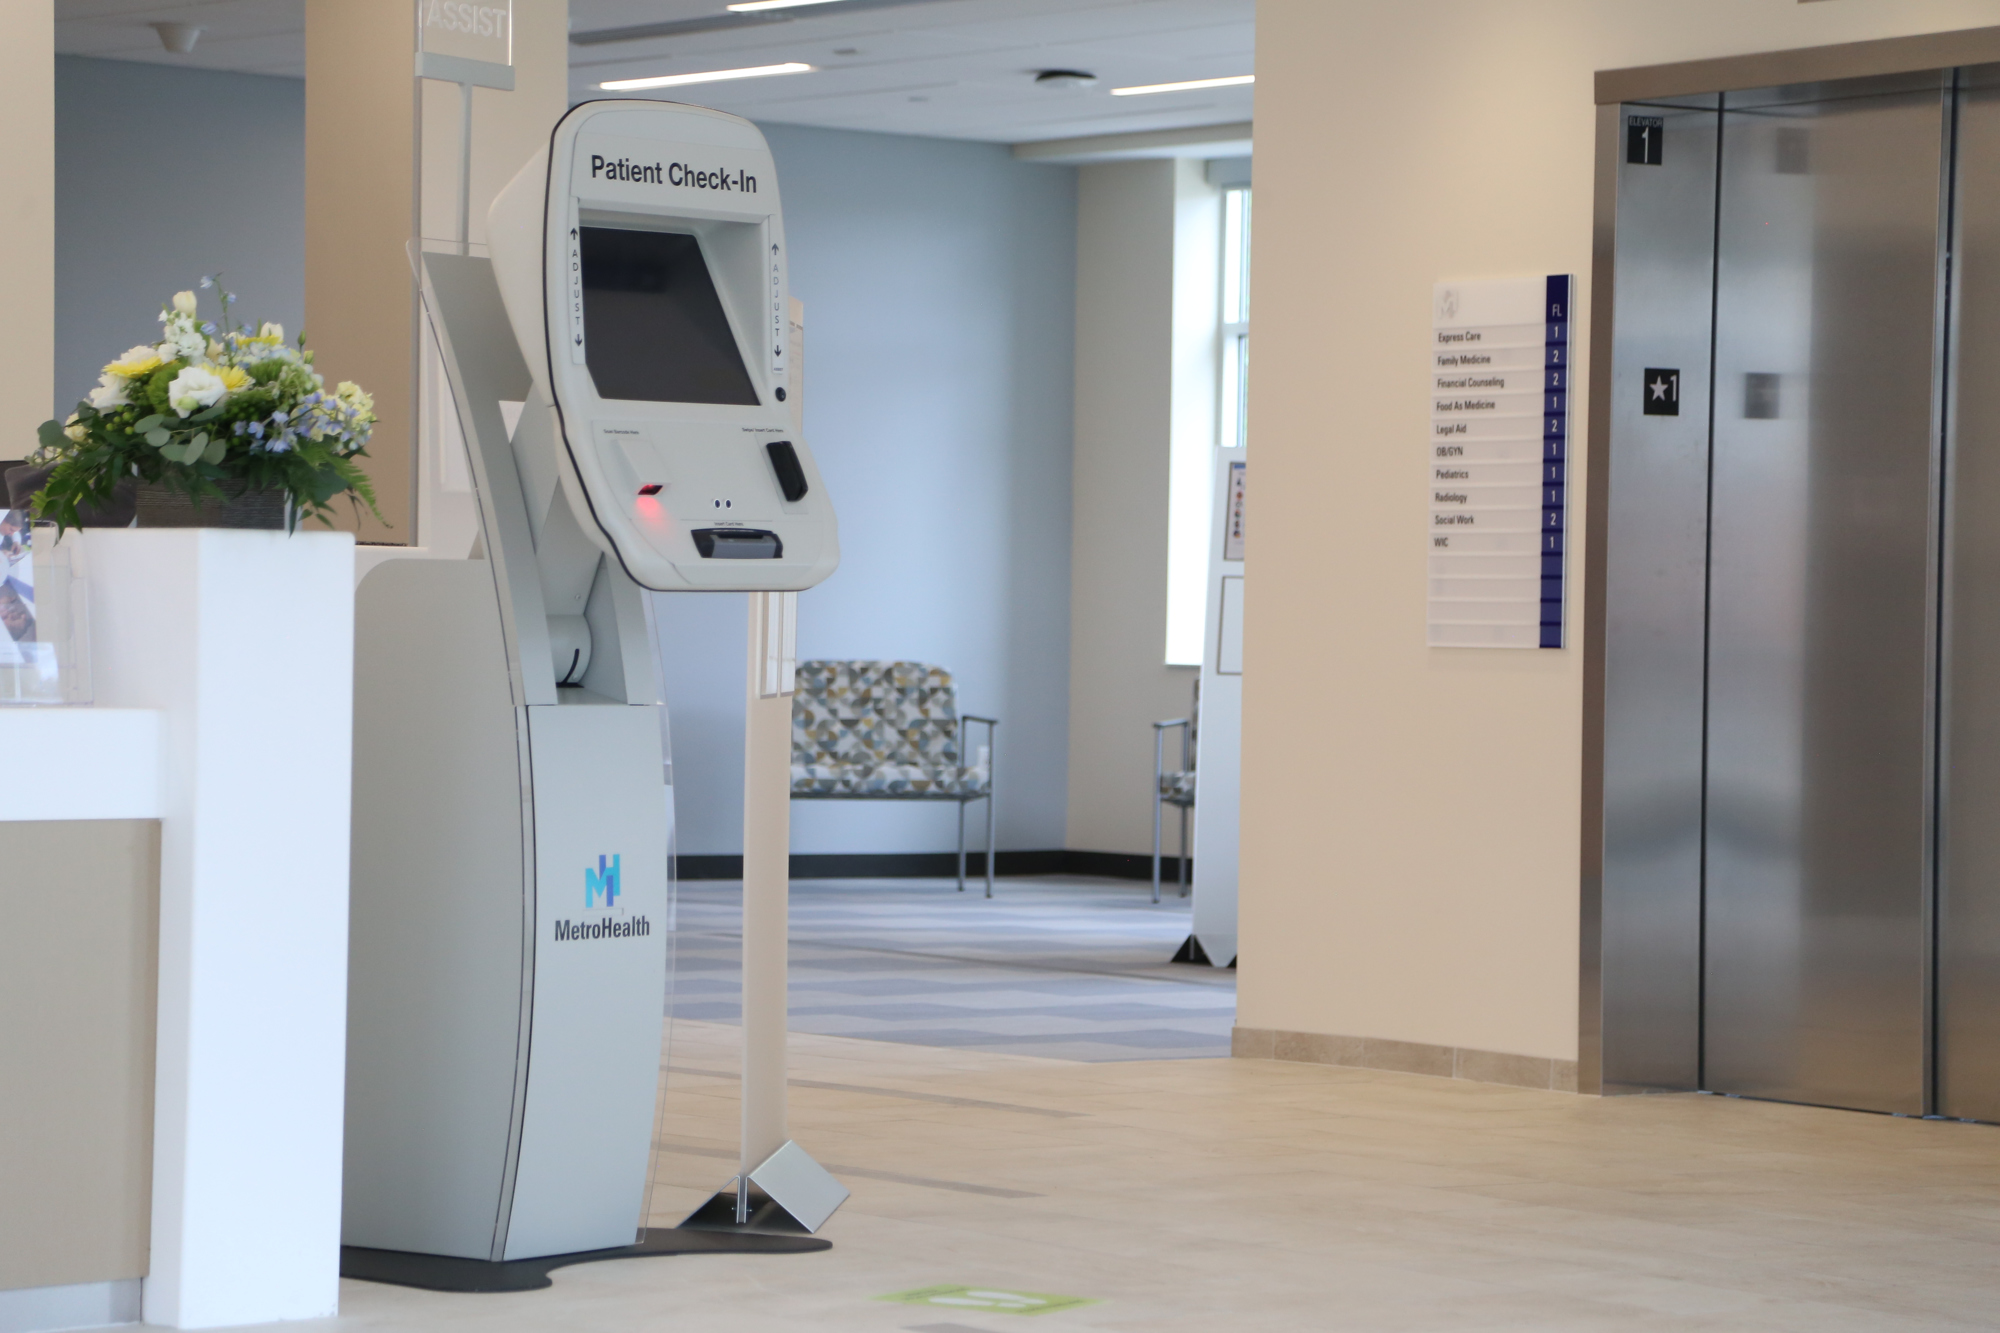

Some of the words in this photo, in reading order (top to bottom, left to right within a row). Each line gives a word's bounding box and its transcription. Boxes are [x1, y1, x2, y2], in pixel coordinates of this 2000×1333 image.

[426, 0, 507, 39] ASSIST
[1629, 117, 1663, 128] ELEVATOR
[1641, 126, 1649, 164] 1
[591, 154, 663, 185] Patient
[668, 162, 757, 194] Check-In
[572, 249, 581, 325] ADJUST
[772, 264, 780, 337] ADJUST
[1552, 304, 1562, 317] FL
[1438, 332, 1464, 344] Express
[1465, 331, 1481, 341] Care
[1554, 326, 1559, 338] 1
[1437, 356, 1459, 367] Family
[1460, 354, 1491, 365] Medicine
[1553, 350, 1559, 363] 2
[1437, 378, 1467, 388] Financial
[1468, 377, 1505, 389] Counseling
[1553, 373, 1559, 386] 2
[1670, 374, 1677, 402] 1
[1436, 401, 1453, 411] Food
[1454, 400, 1463, 410] As
[1464, 399, 1496, 410] Medicine
[1553, 396, 1557, 408] 1
[1436, 424, 1454, 436] Legal
[1455, 423, 1467, 433] Aid
[1552, 419, 1558, 432] 2
[1436, 446, 1463, 457] OB/GYN
[1552, 443, 1557, 455] 1
[1436, 469, 1469, 479] Pediatrics
[1551, 466, 1556, 479] 1
[1435, 492, 1467, 504] Radiology
[1551, 490, 1556, 503] 1
[1435, 514, 1455, 525] Social
[1456, 514, 1474, 524] Work
[1550, 513, 1557, 526] 2
[1434, 537, 1449, 547] WIC
[1550, 536, 1554, 549] 1
[555, 915, 650, 941] MetroHealth
